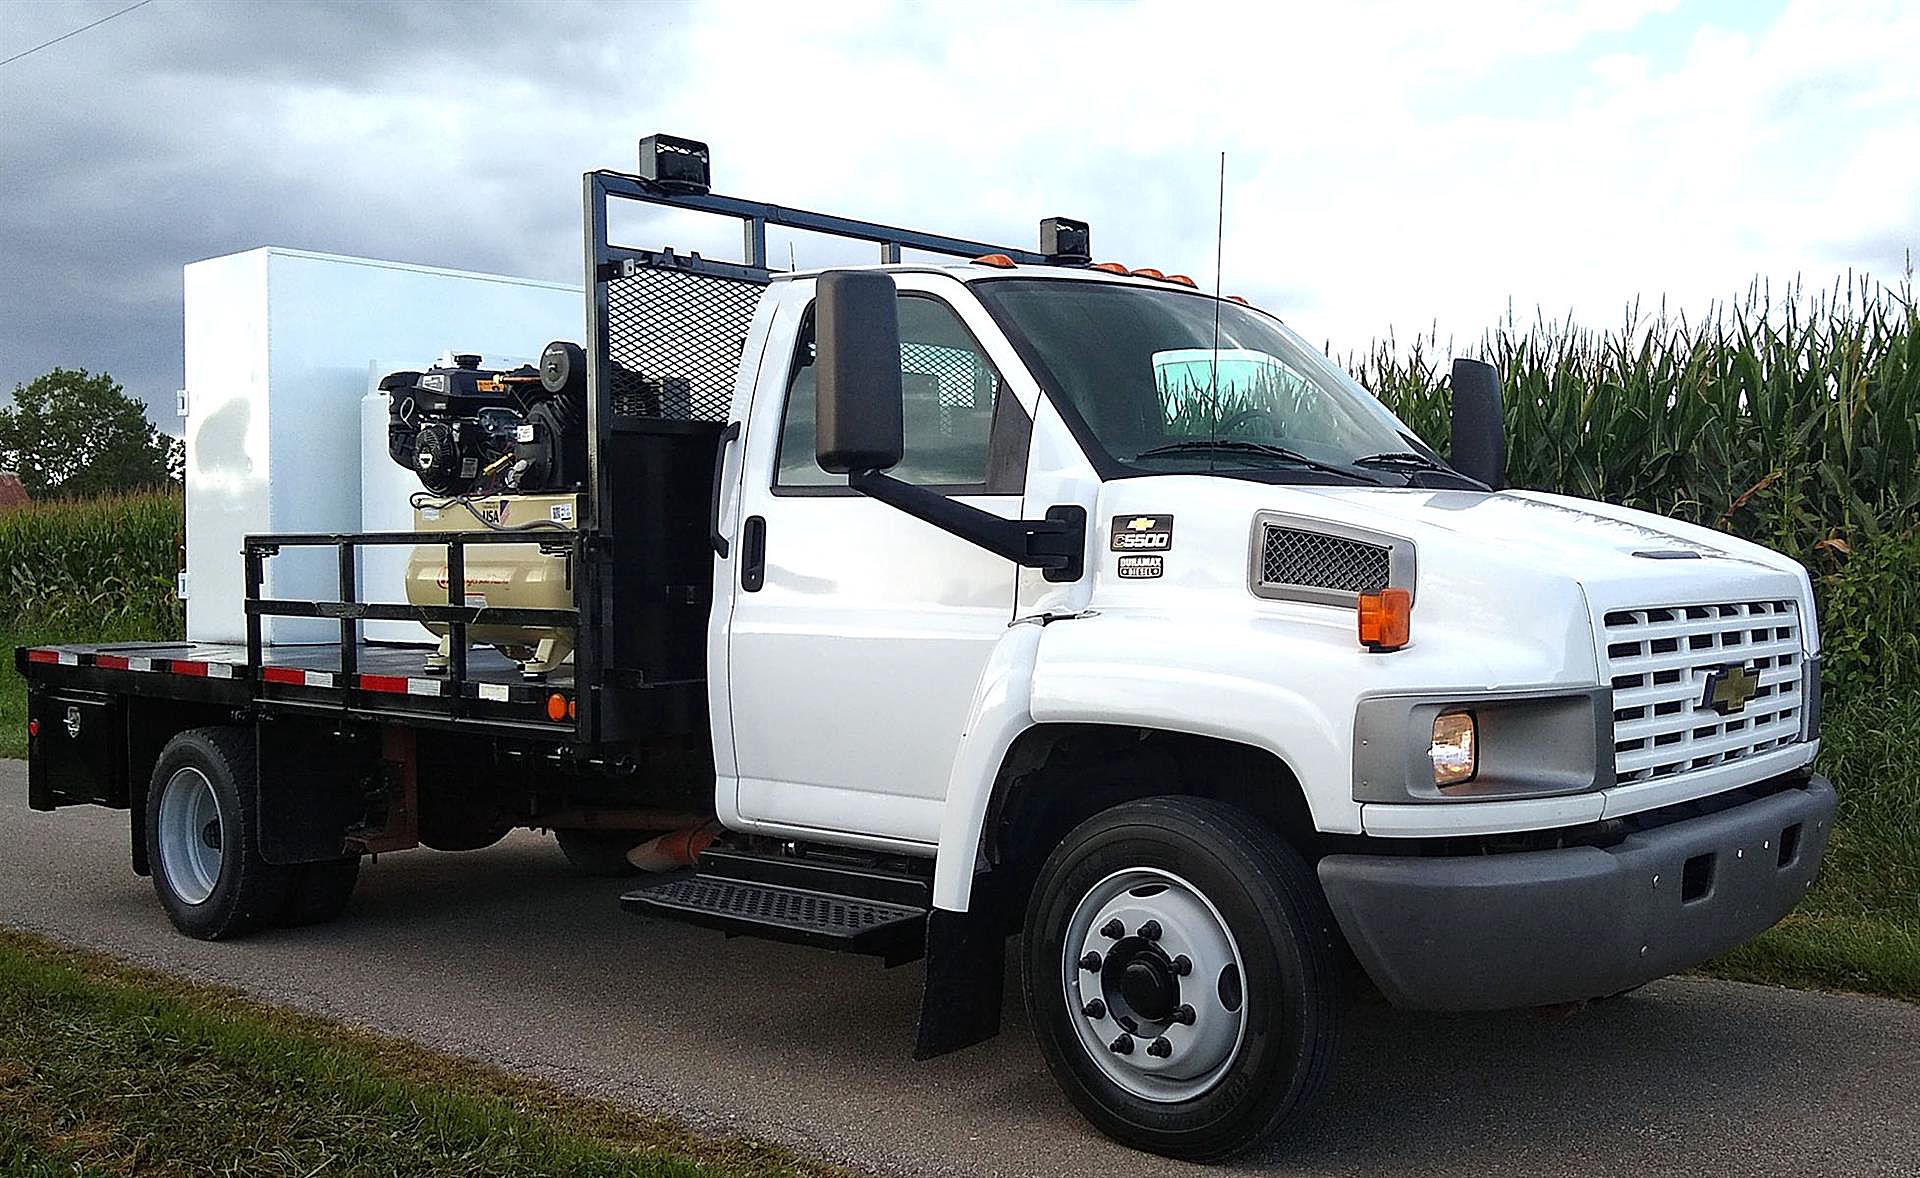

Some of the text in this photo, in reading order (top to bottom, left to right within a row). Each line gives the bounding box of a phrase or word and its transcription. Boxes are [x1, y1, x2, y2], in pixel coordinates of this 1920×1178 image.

[482, 510, 500, 523] USA
[1113, 533, 1169, 548] C5500
[1120, 557, 1161, 567] DURAMAX
[1128, 568, 1153, 576] DIESEL
